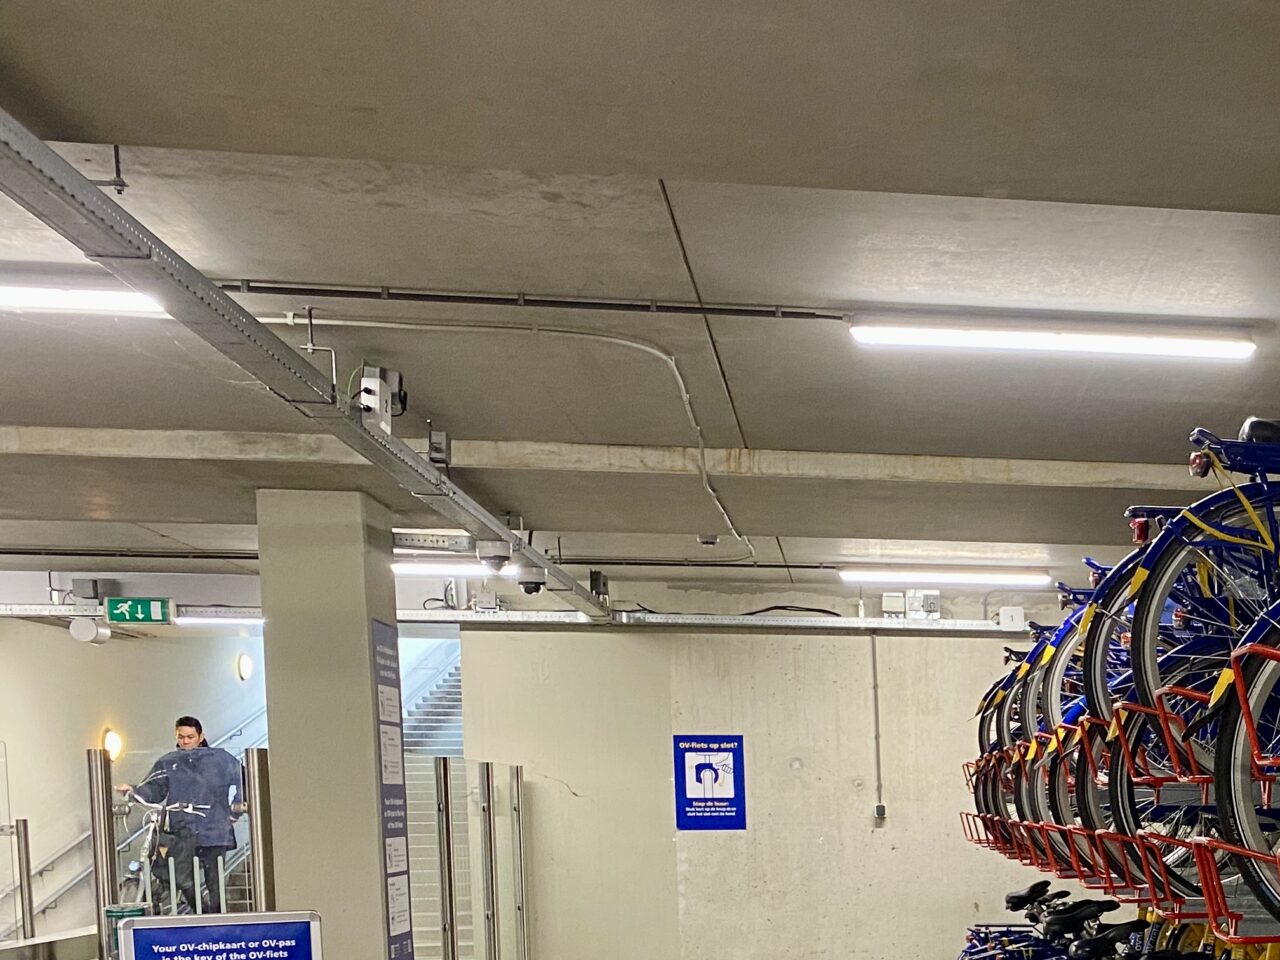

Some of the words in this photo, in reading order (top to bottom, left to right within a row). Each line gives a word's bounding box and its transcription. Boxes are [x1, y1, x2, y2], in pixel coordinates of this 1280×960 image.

[152, 945, 177, 953] Your
[179, 940, 246, 952] OV-chipkaart
[248, 941, 259, 949] or
[262, 939, 296, 948] OV-pas
[215, 952, 227, 960] of
[229, 951, 246, 960] the
[249, 950, 289, 960] OV-fiets
